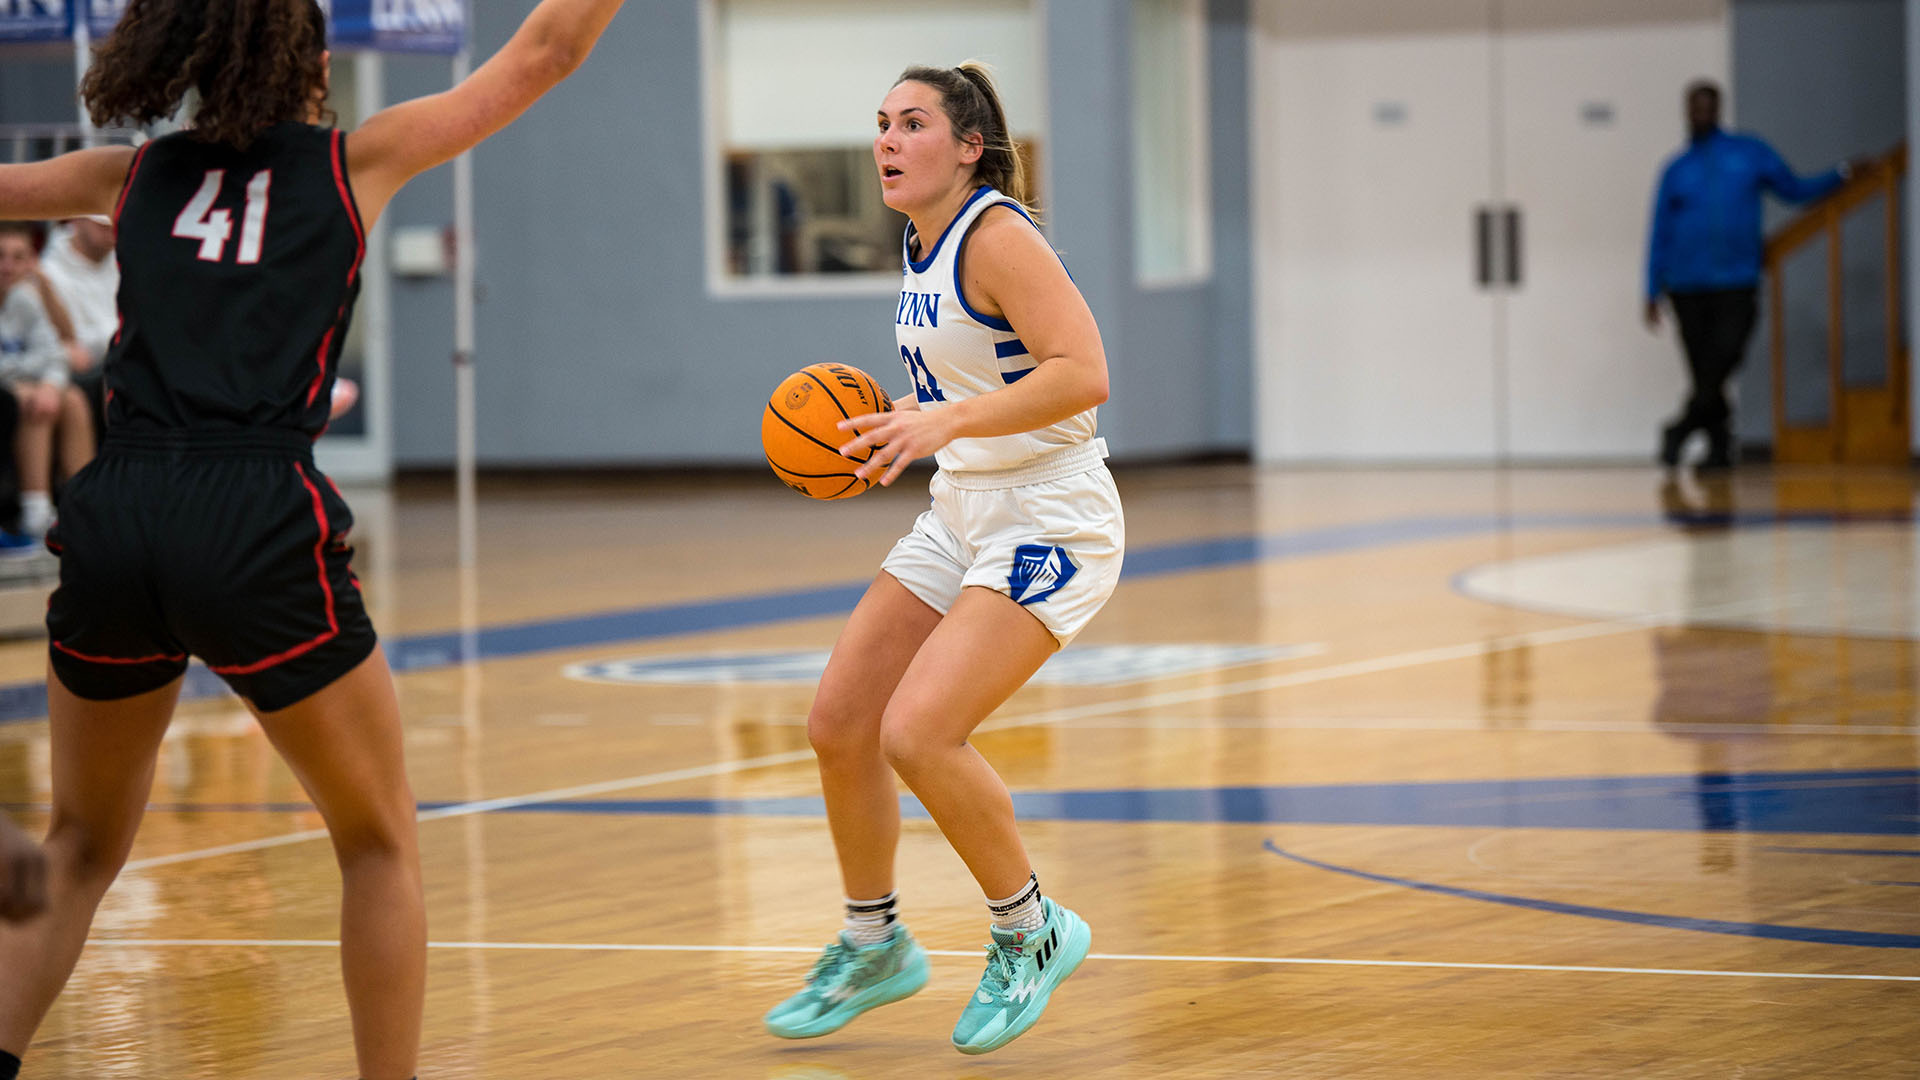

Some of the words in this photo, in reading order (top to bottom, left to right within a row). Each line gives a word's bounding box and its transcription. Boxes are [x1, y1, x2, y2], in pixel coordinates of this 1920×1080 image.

[171, 168, 272, 264] 41
[897, 291, 941, 328] YNN
[900, 344, 947, 403] 21
